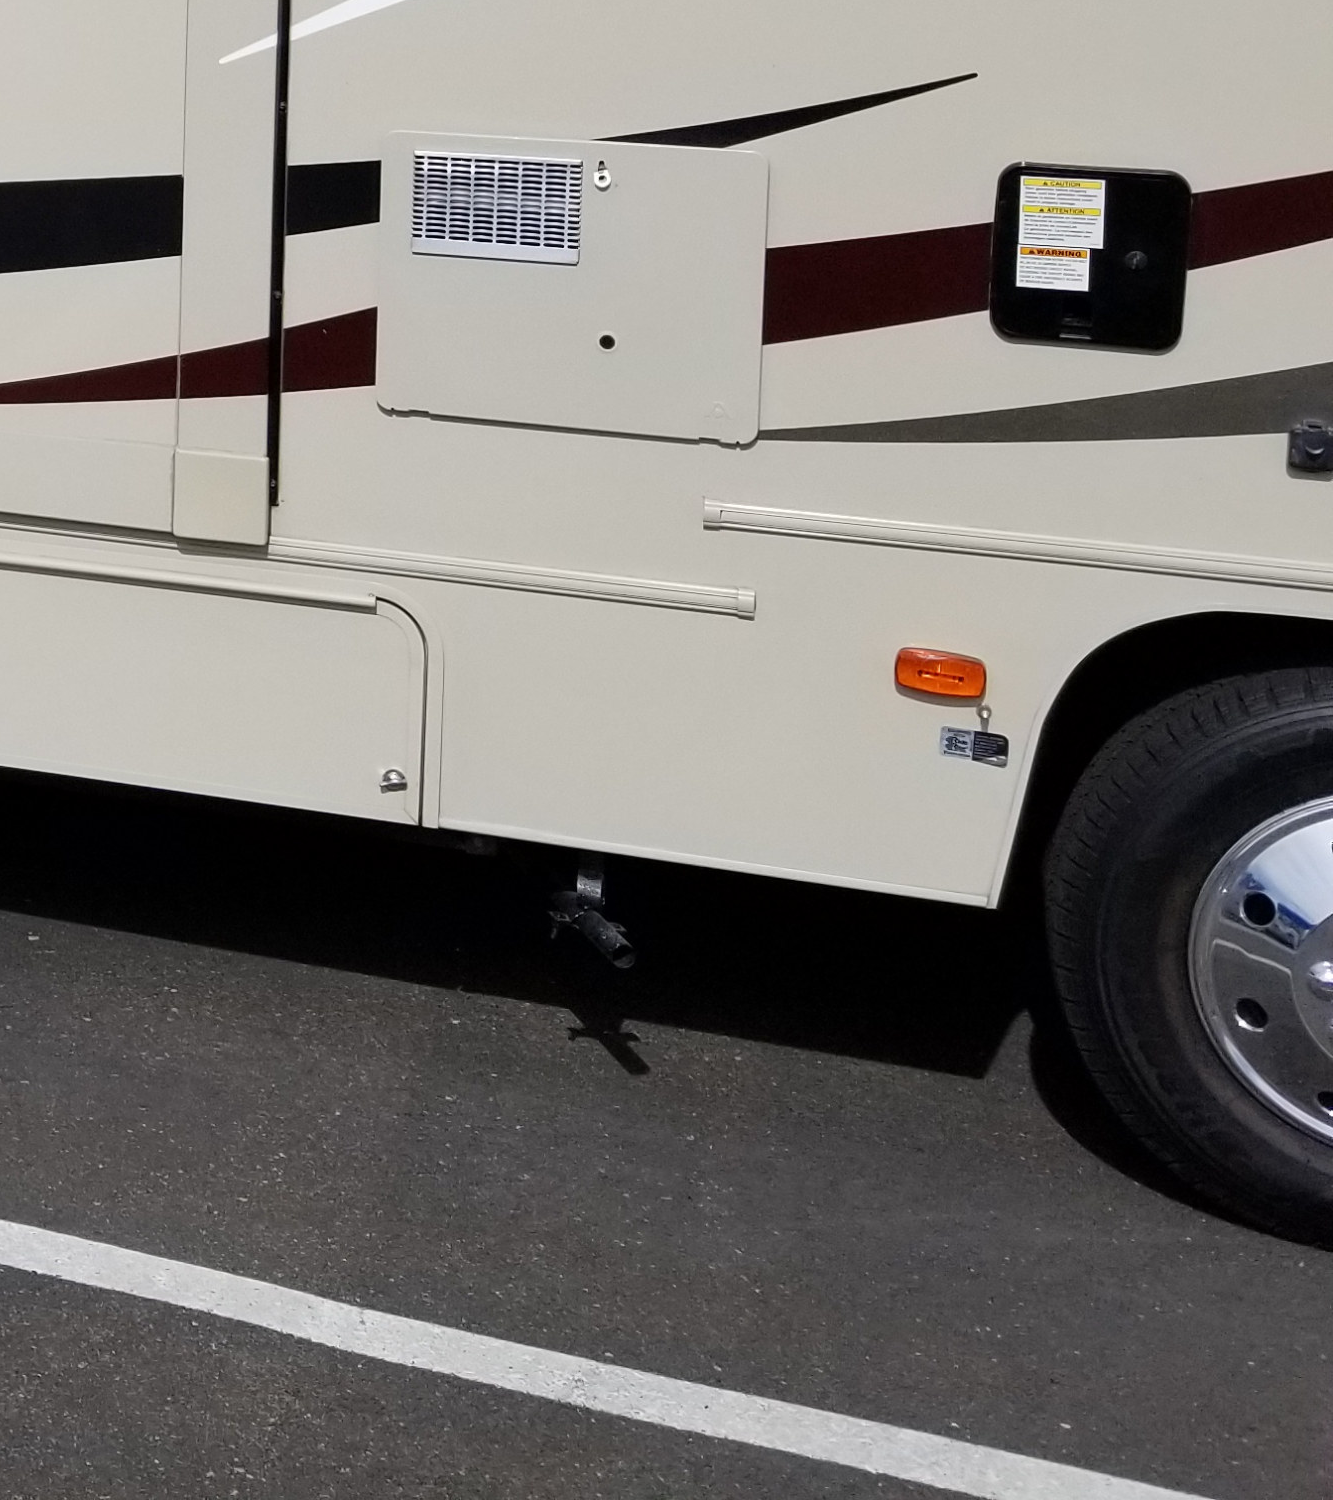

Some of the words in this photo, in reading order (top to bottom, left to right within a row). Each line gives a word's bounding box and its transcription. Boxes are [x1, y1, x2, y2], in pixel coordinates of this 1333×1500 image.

[1049, 180, 1081, 188] CAUTION
[1047, 207, 1085, 215] ATTENTION
[1036, 249, 1082, 258] WARNING
